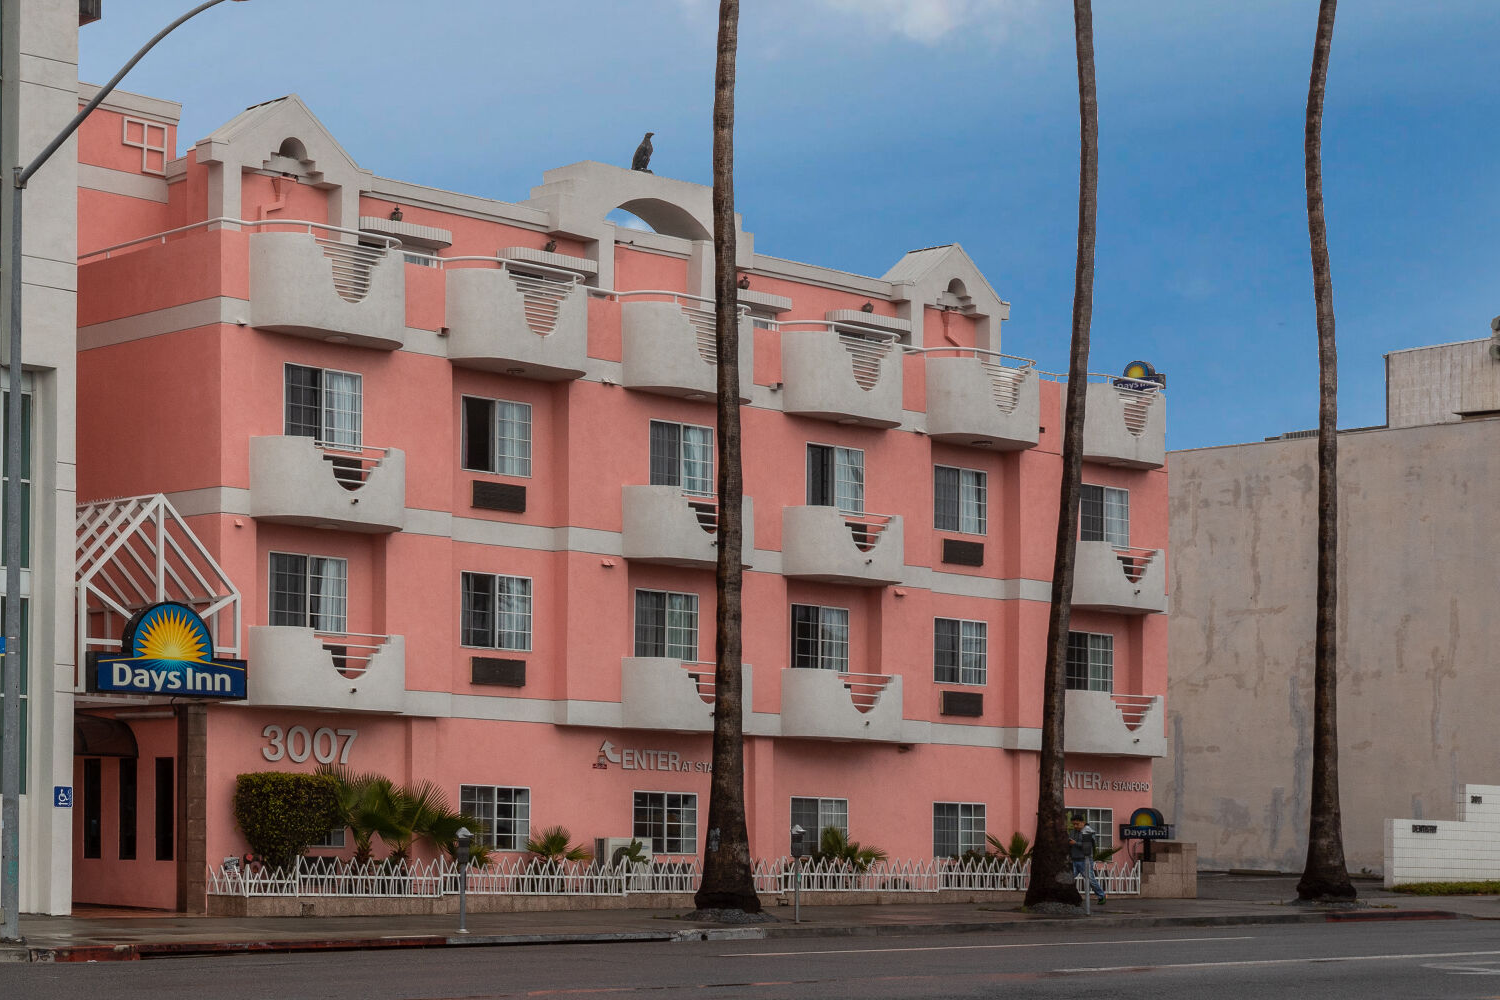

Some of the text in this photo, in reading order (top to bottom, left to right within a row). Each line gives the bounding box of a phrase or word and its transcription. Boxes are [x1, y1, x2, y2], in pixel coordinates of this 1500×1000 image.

[112, 663, 232, 692] Days Inn
[262, 725, 358, 764] 3007
[622, 749, 681, 771] ENTER
[681, 761, 693, 772] AT
[1064, 770, 1151, 792] NTER AT STANFORD
[1124, 828, 1147, 838] Days
